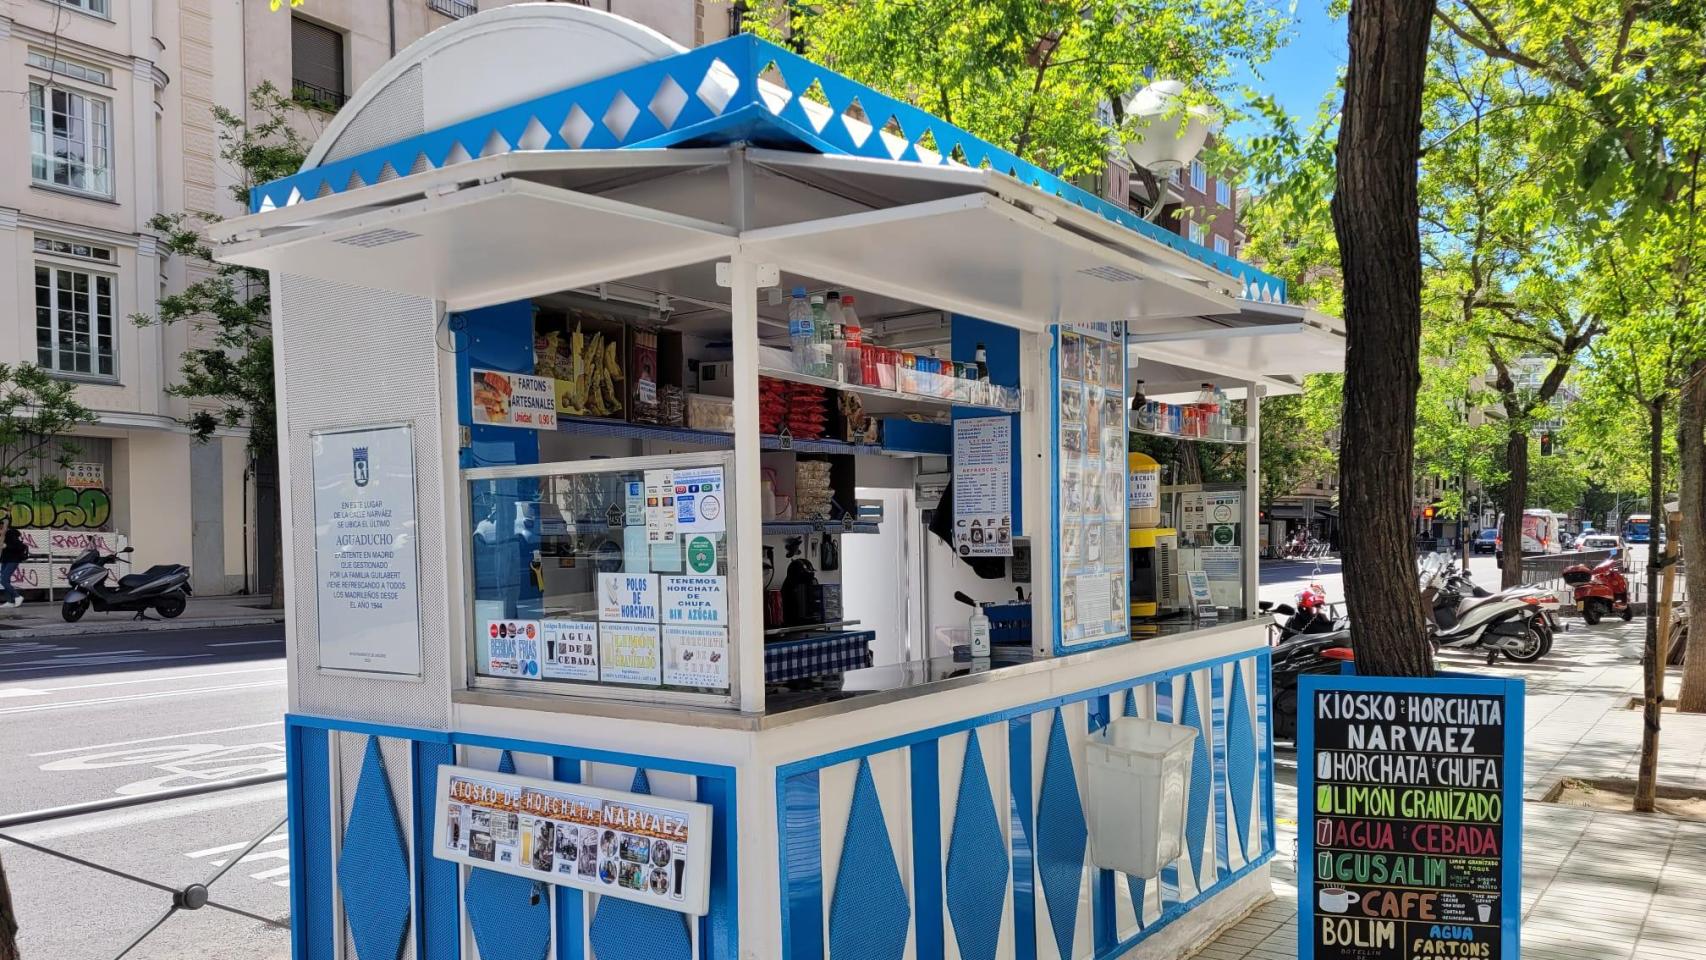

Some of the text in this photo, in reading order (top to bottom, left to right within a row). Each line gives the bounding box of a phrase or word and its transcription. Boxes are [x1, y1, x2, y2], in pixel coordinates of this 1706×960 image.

[518, 378, 546, 392] FARTONS
[511, 395, 554, 410] ARTESANALES
[514, 411, 532, 423] Unidad
[341, 501, 349, 509] EN
[364, 500, 382, 508] LUGAR
[333, 511, 341, 519] DE
[342, 511, 349, 519] LA
[335, 533, 394, 546] AGUADUCHO
[373, 550, 394, 559] MADRID
[353, 561, 389, 569] GESTIONADO
[349, 571, 370, 579] FAMILIA
[387, 581, 406, 590] TODOS
[627, 578, 647, 591] POLOS
[345, 589, 380, 599] MADRILEÑOS
[381, 591, 399, 600] DESDE
[633, 592, 641, 604] DE
[621, 605, 655, 620] HORCHATA
[670, 608, 718, 621] SIN AZÚCAR
[561, 632, 592, 642] AGUA
[491, 639, 516, 659] BEBIDAS
[569, 644, 582, 653] DE
[558, 656, 596, 666] CEBADA
[1318, 692, 1396, 721] KIOSKO
[1408, 696, 1502, 725] HORCHATA
[1348, 725, 1475, 753] NARVAEZ
[1334, 752, 1430, 785] HORCHATA
[1437, 758, 1499, 788] CHUFA
[1334, 785, 1395, 817] LIMÓN
[450, 780, 685, 837] KIOSKO DE HORCHATA NARVAEZ
[1334, 819, 1395, 849] AGUA
[1411, 824, 1498, 855] CEBADA
[1335, 853, 1447, 887] GUSALIM
[1322, 917, 1395, 949] BOLIM
[1429, 924, 1473, 941] AGUA
[1413, 938, 1490, 957] FARTONS
